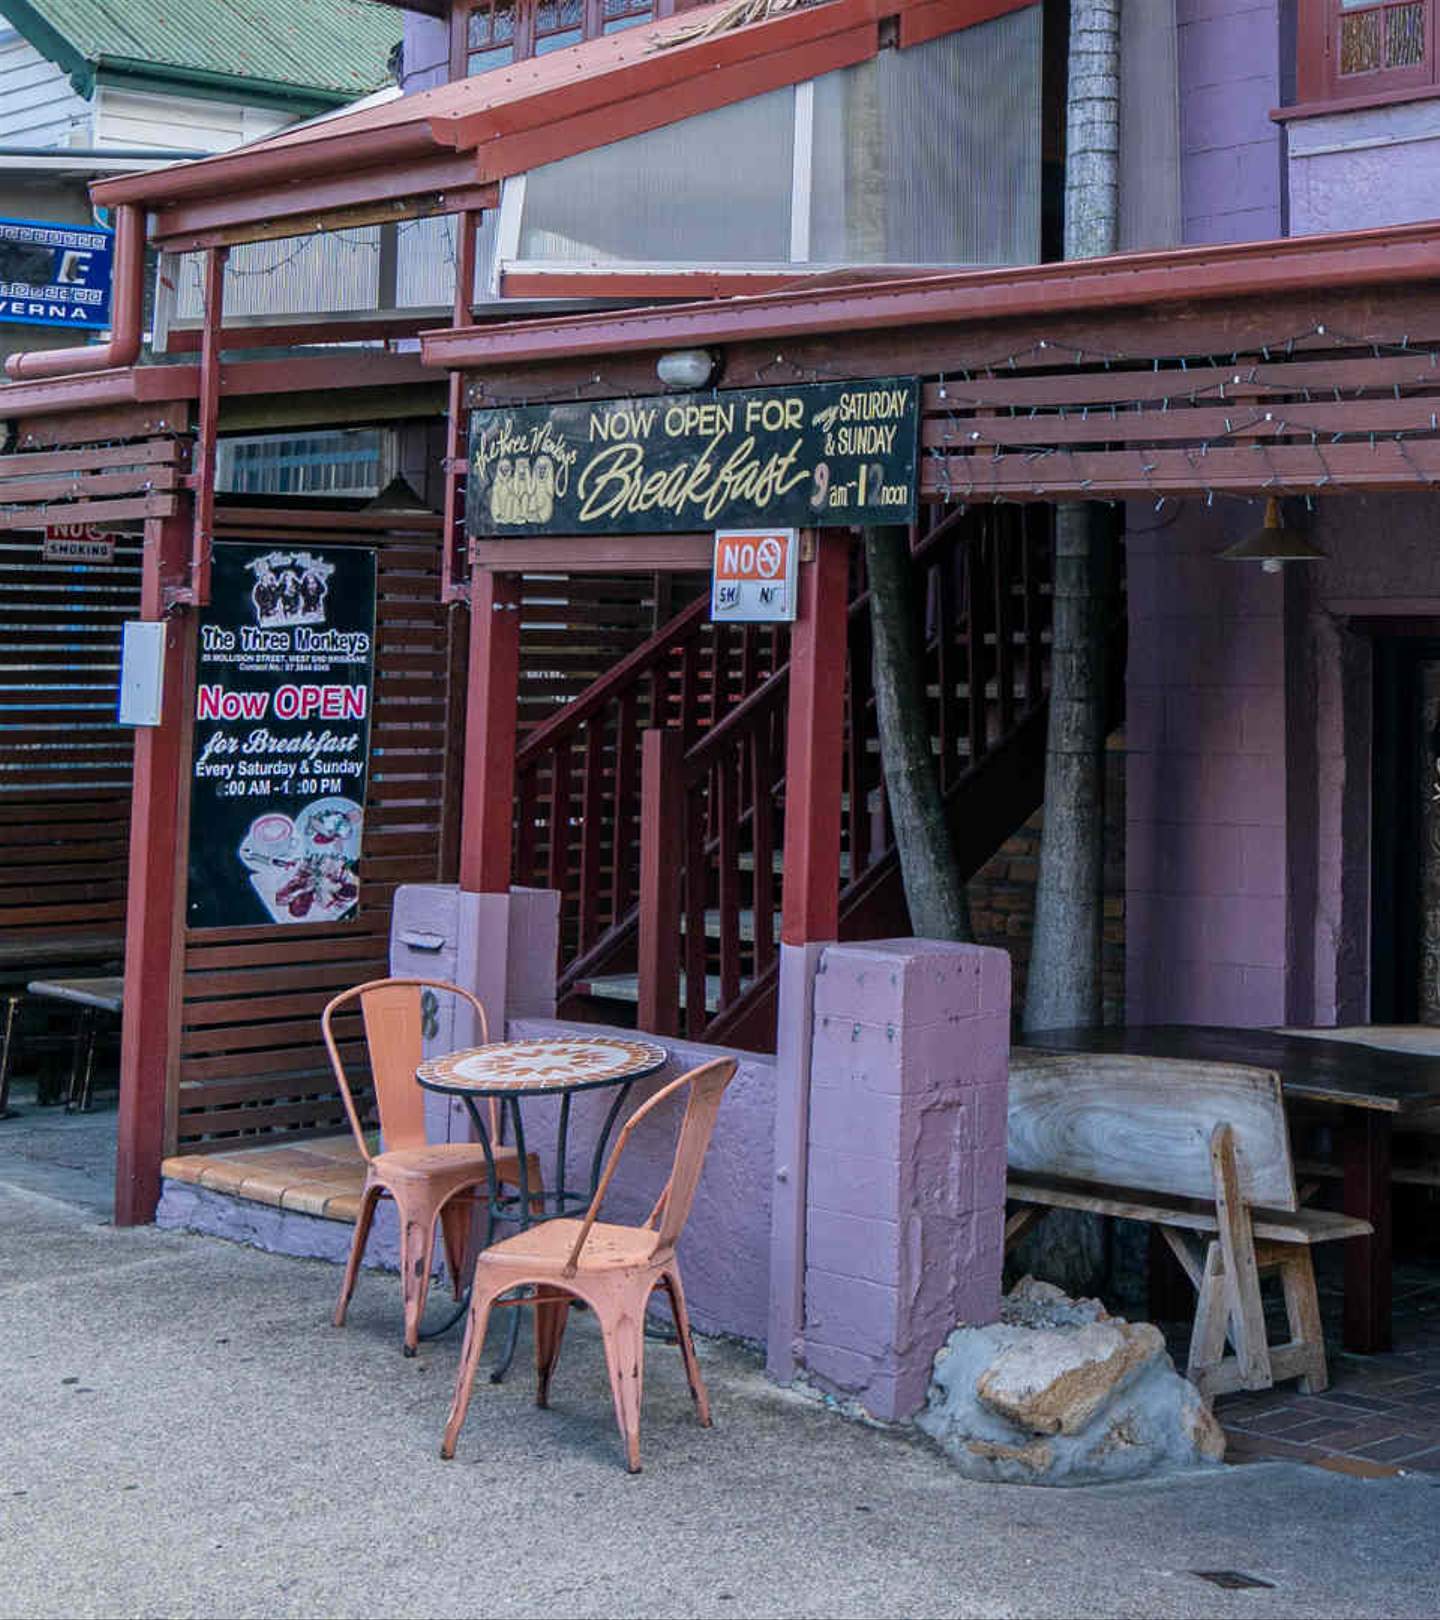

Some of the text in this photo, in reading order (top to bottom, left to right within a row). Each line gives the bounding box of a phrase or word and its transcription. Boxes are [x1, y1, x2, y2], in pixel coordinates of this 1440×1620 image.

[0, 301, 88, 320] ERNA
[589, 412, 654, 442] NOW
[664, 403, 735, 437] OPEN
[745, 398, 805, 433] FOR
[839, 388, 909, 421] SATURDAY
[577, 423, 898, 522] Breakfast & SUNDAY
[722, 542, 755, 577] NO
[201, 624, 370, 656] The Three Monkeys
[197, 684, 367, 721] Now OPEN
[200, 728, 361, 763] for Breakfast
[195, 759, 365, 780] Every Saturday & Sunday
[249, 779, 271, 796] AM
[320, 777, 342, 794] PM
